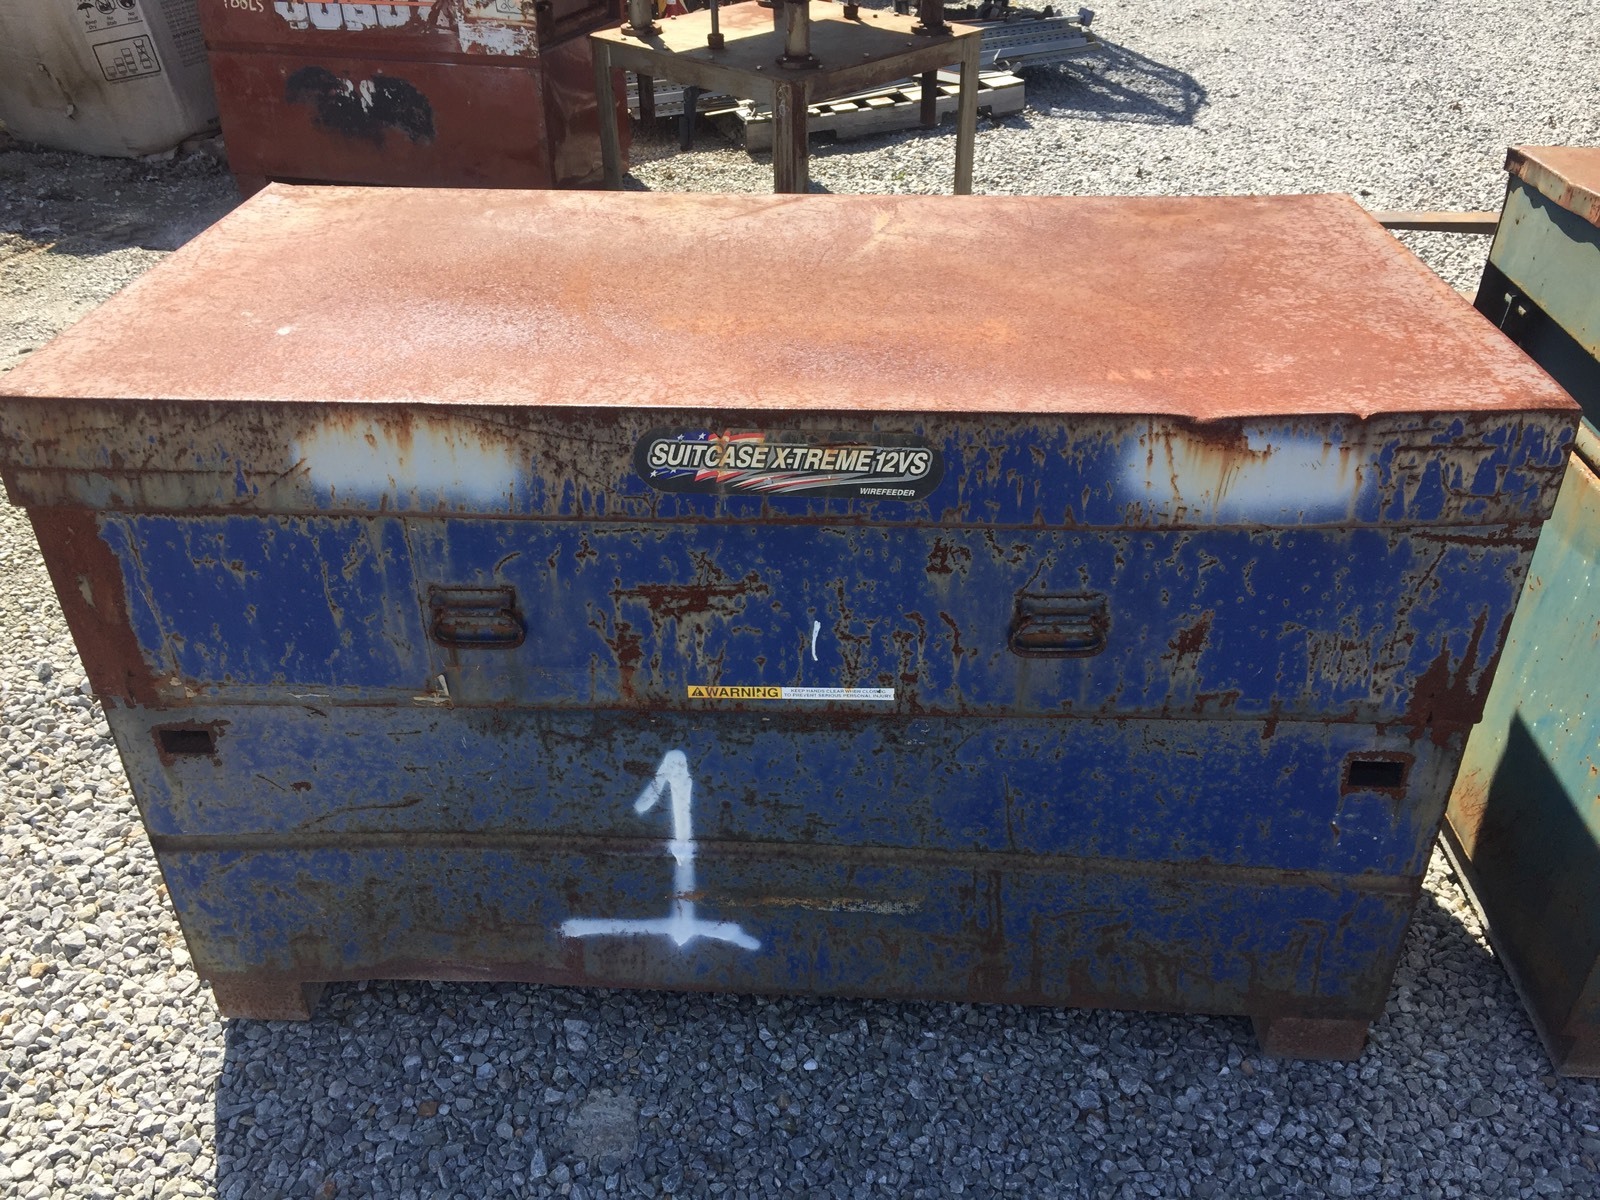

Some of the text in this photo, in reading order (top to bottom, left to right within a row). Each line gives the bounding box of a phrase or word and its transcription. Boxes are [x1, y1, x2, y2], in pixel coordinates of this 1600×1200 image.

[651, 443, 929, 475] SUITCASE X-TREME 12VS
[859, 487, 916, 497] WIREFEEDER
[705, 687, 779, 698] WARNING
